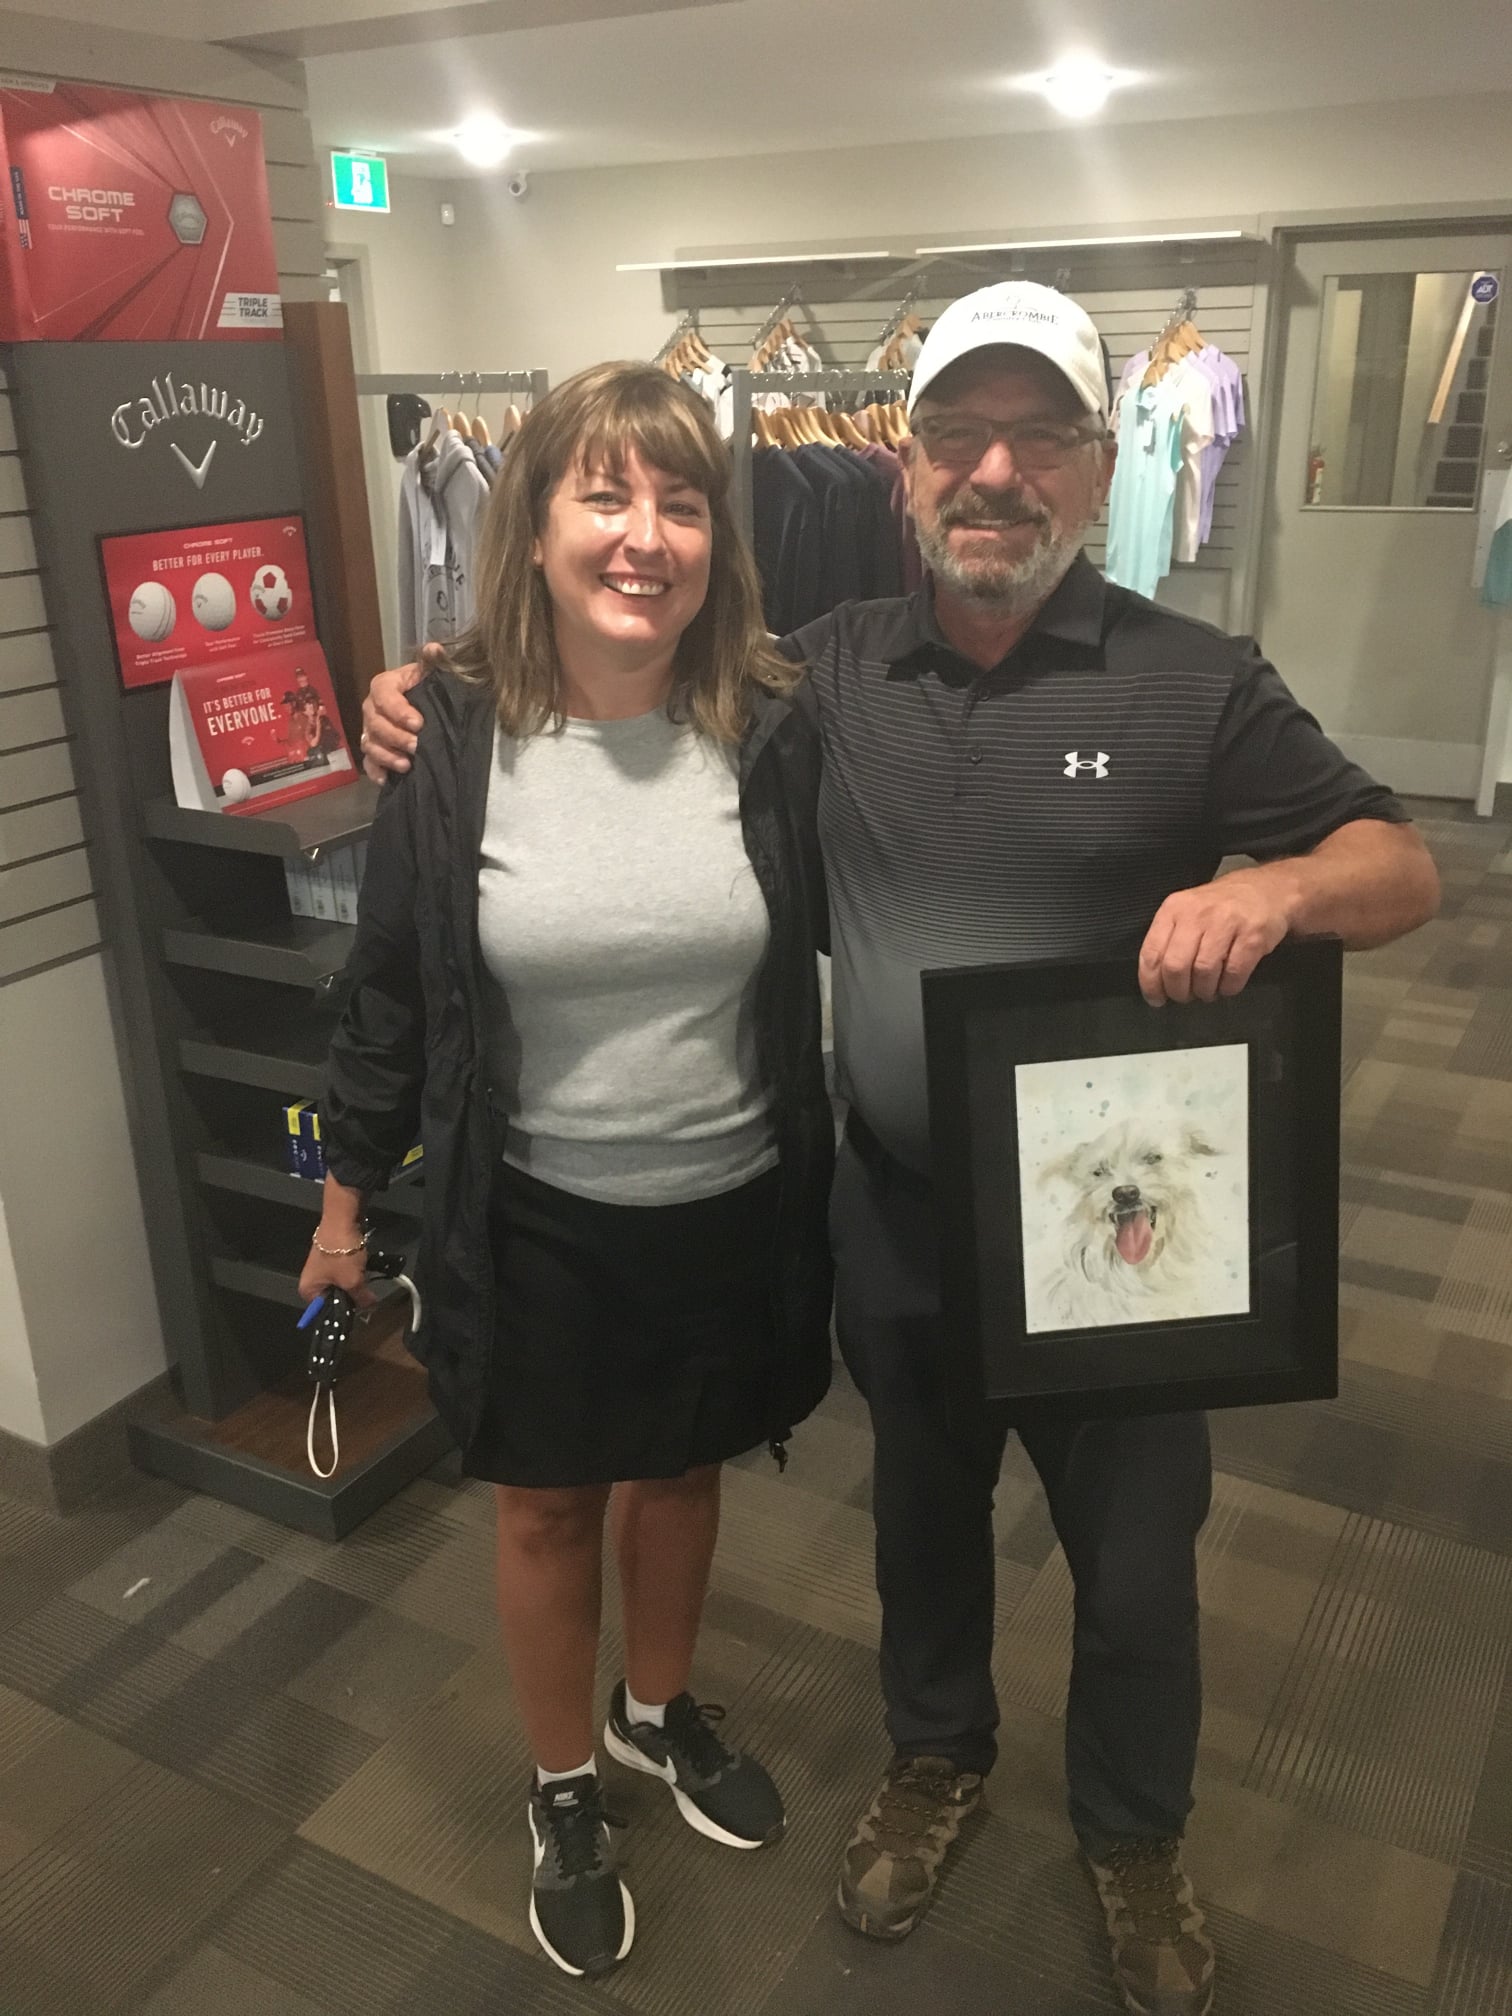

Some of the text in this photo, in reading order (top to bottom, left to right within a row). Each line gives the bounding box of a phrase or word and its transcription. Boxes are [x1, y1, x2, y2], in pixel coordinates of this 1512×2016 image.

[48, 186, 136, 206] CHROME
[65, 205, 124, 222] SOFT
[238, 297, 268, 308] TRIPLE
[239, 307, 268, 318] TRACK
[111, 371, 264, 449] Callaway
[152, 546, 265, 571] BETTER FOR EVERY PLAYER.
[203, 687, 271, 714] IT'S BETTER FOR
[207, 702, 282, 736] EVERYONE.
